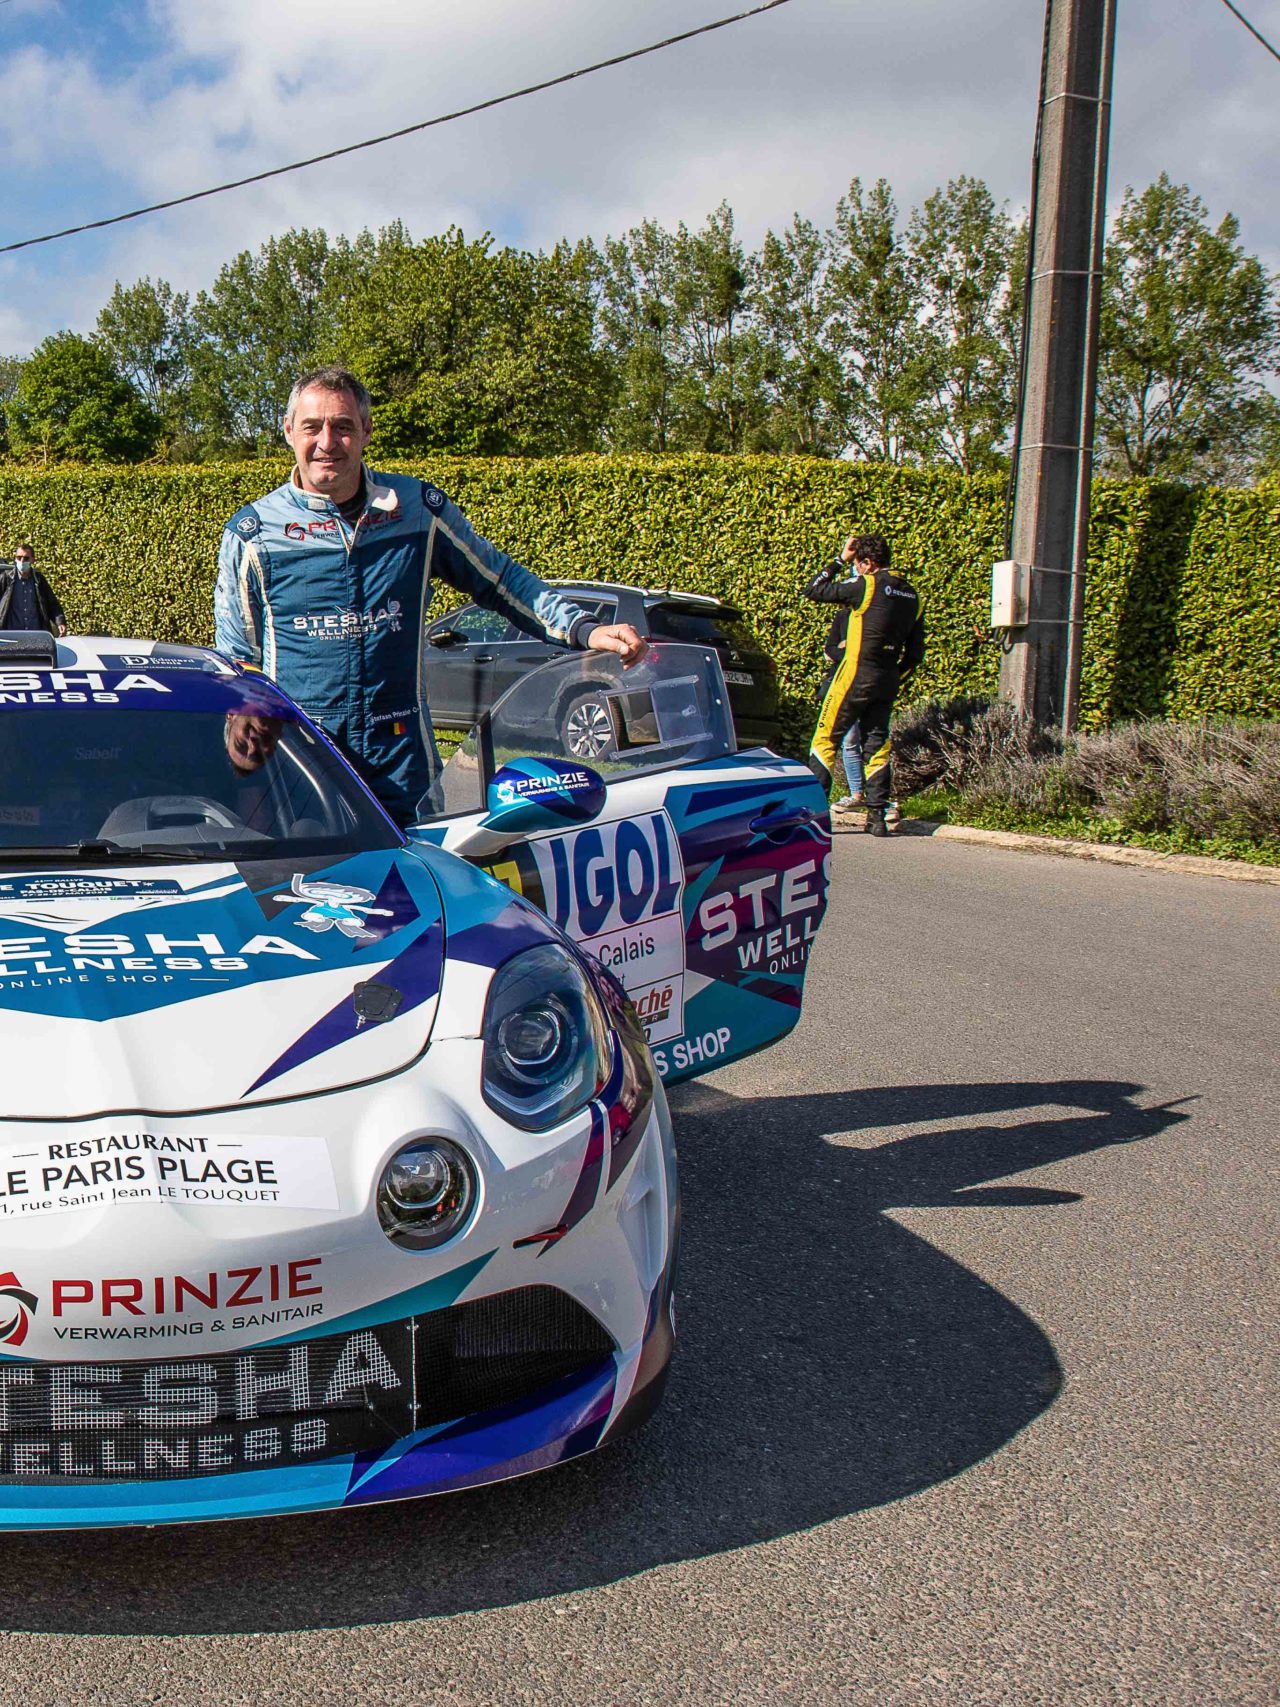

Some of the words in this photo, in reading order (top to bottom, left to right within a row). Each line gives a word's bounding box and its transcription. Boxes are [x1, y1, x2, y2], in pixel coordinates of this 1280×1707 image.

[516, 771, 589, 792] PRINZIE
[25, 880, 141, 890] TOUQUET
[549, 813, 682, 937] IGOL
[700, 852, 832, 951] STE
[600, 932, 655, 968] Calais
[738, 916, 819, 969] WELL
[769, 944, 812, 975] ONLI
[104, 974, 174, 986] SHOP
[672, 1027, 732, 1069] SHOP
[47, 1134, 210, 1160] RESTAURANT
[42, 1155, 147, 1193] PARIS
[159, 1156, 278, 1185] PLAGE
[21, 1200, 52, 1212] rue
[59, 1191, 106, 1207] Saint
[111, 1186, 152, 1201] Jean
[158, 1184, 177, 1198] LE
[180, 1189, 280, 1203] TOUQUET
[52, 1257, 323, 1317] PRINZIE
[53, 1321, 204, 1340] VERWARMING
[211, 1318, 227, 1332] &
[230, 1303, 324, 1328] SANITAIR
